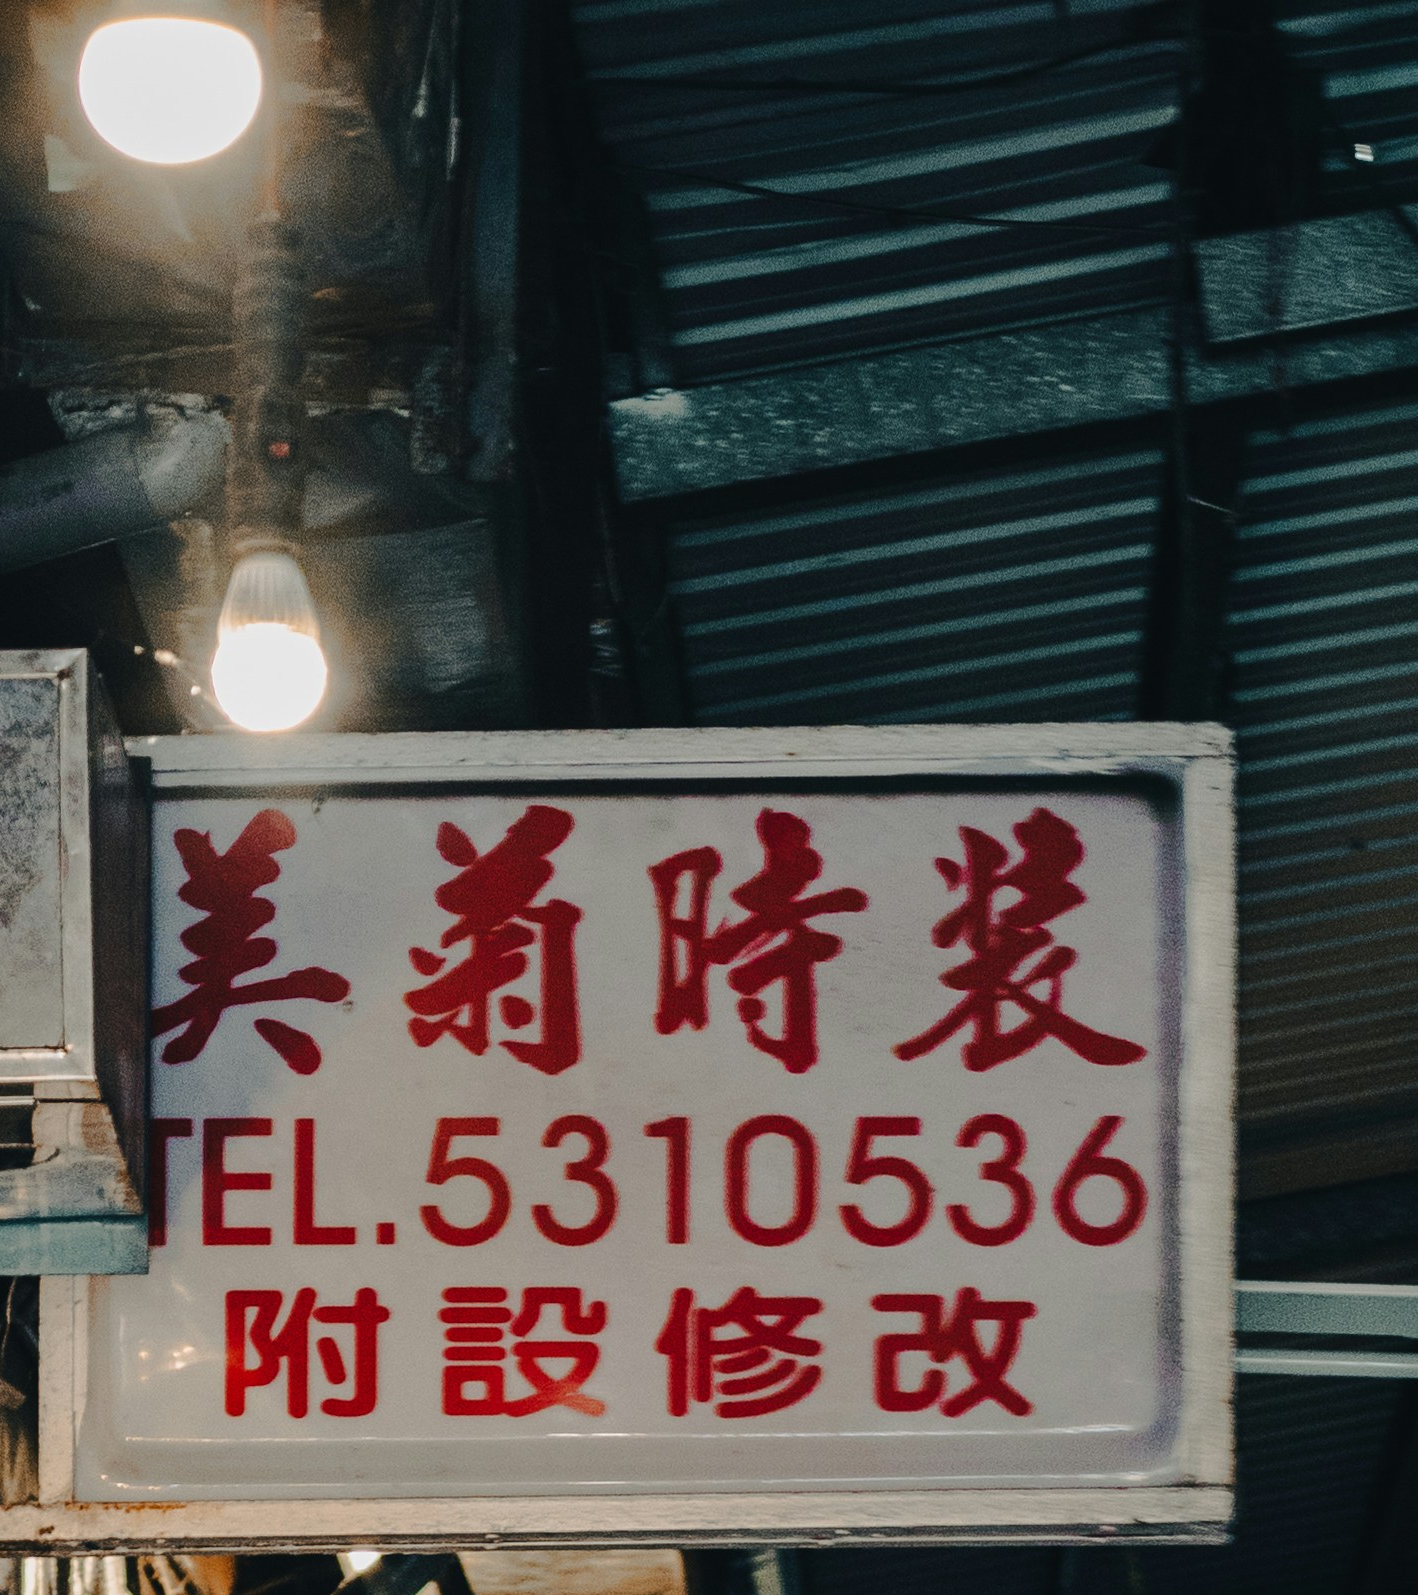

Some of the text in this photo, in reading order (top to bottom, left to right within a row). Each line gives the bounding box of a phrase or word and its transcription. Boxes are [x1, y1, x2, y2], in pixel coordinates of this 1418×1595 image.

[149, 804, 1148, 1076] 美菊時裝
[149, 1113, 1148, 1248] TEL.5310536
[223, 1284, 1038, 1420] 附設修改
